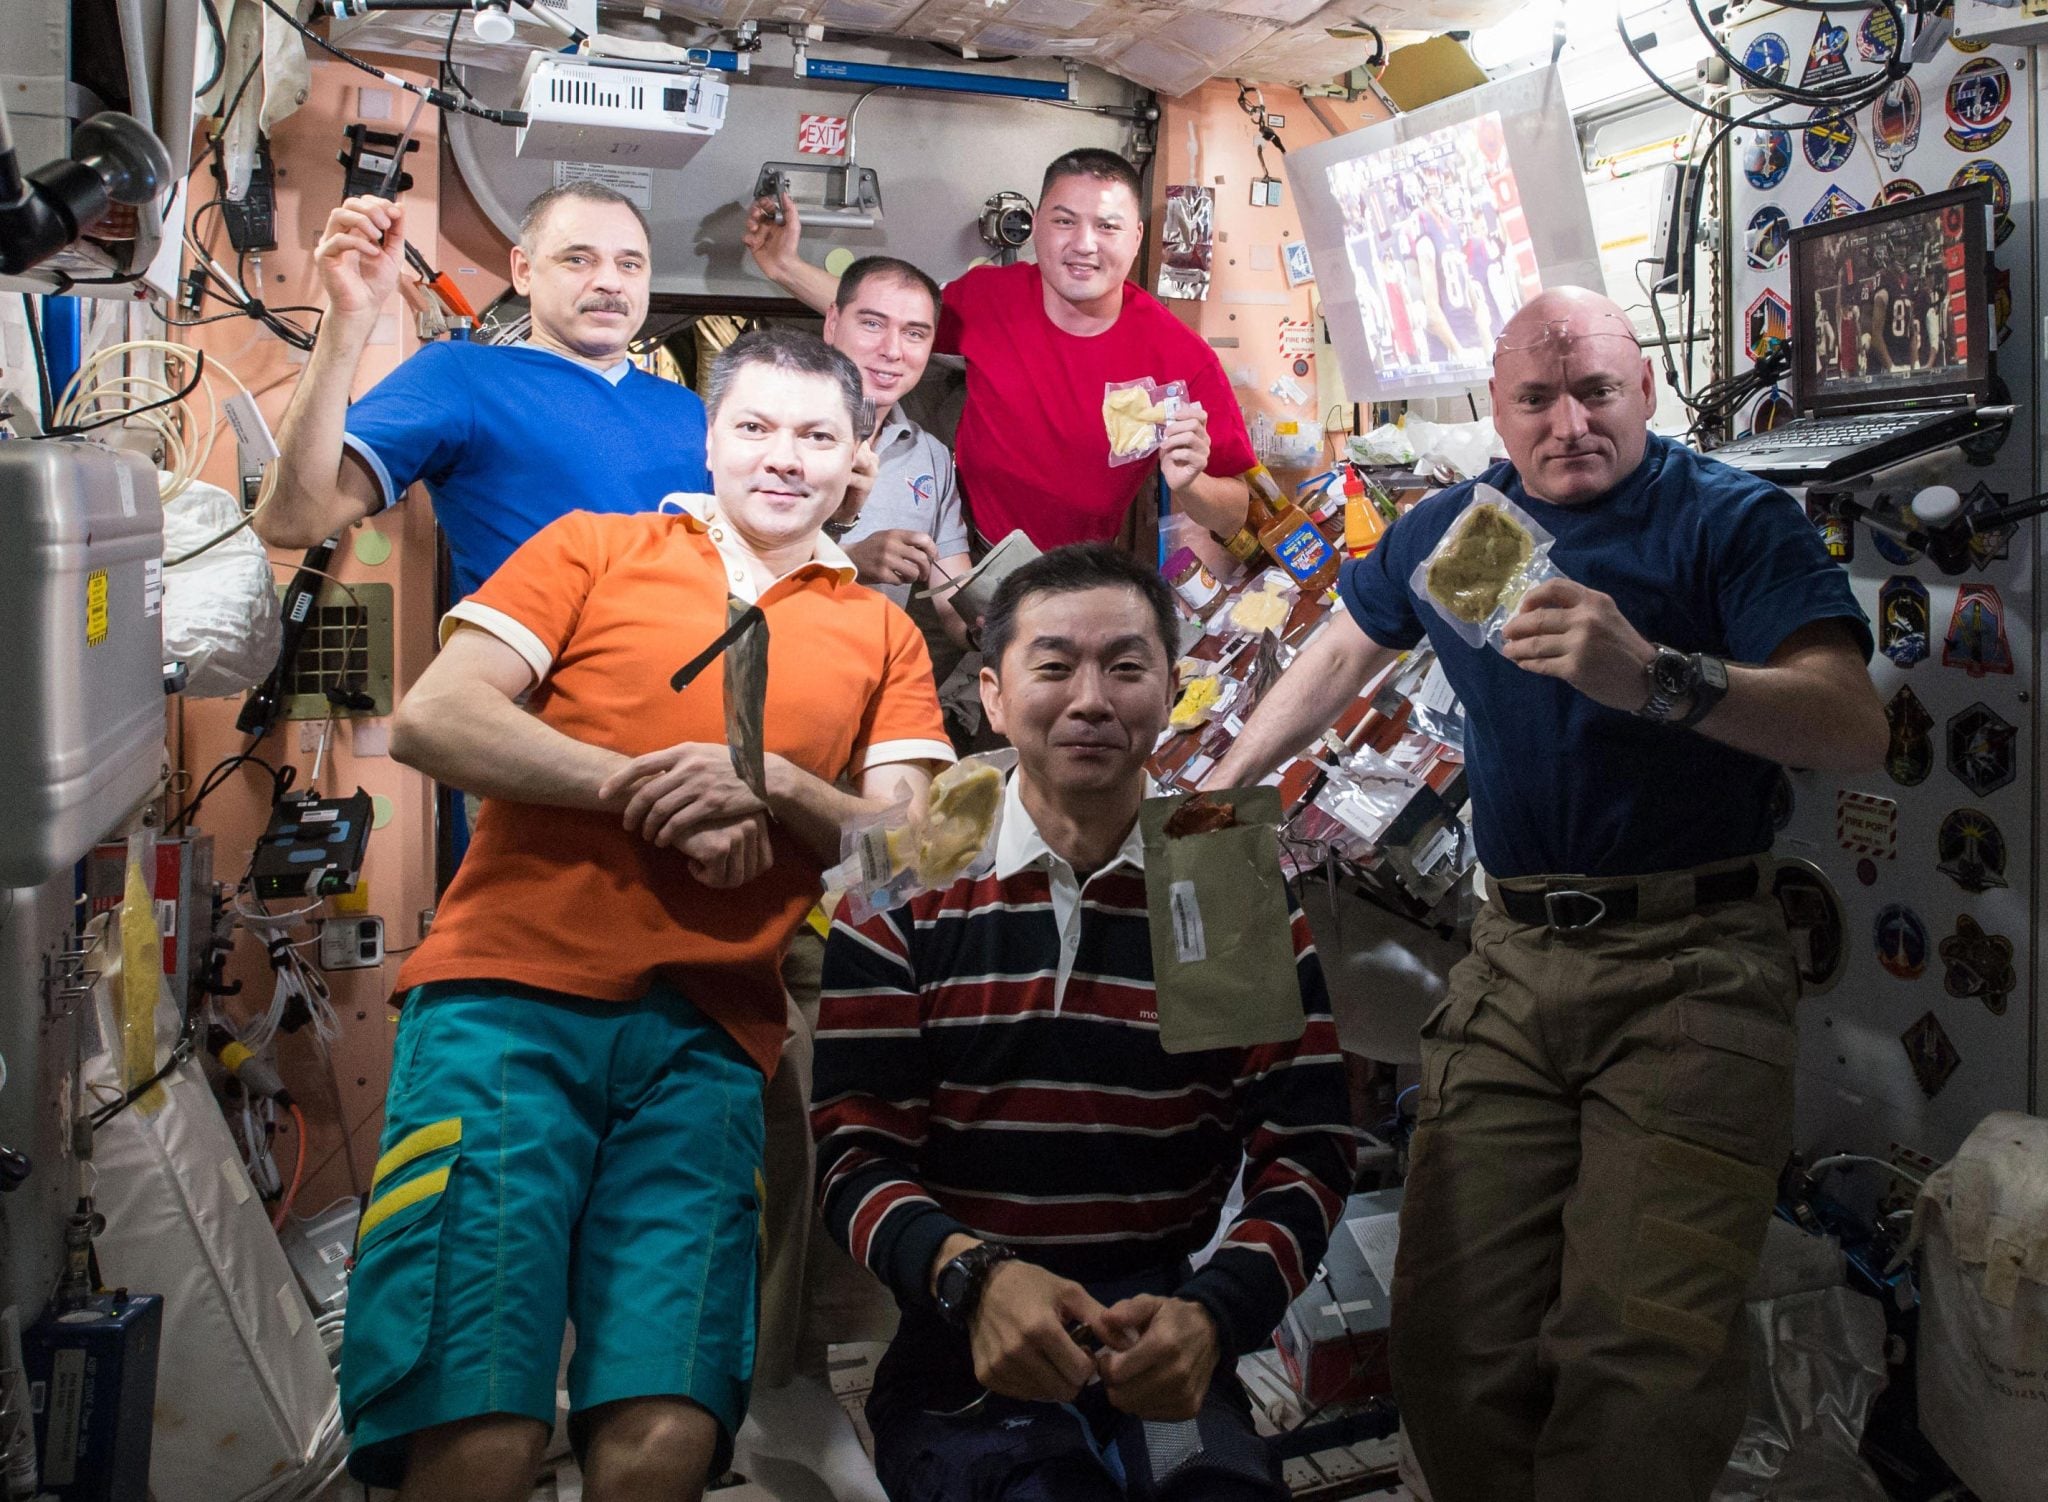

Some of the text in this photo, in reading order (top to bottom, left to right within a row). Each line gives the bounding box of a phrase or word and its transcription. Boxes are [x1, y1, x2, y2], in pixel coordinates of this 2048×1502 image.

[806, 124, 840, 146] EXIT
[1285, 336, 1315, 345] FIRE POR
[1845, 815, 1889, 833] FIRE PORT
[1139, 1010, 1158, 1020] mo
